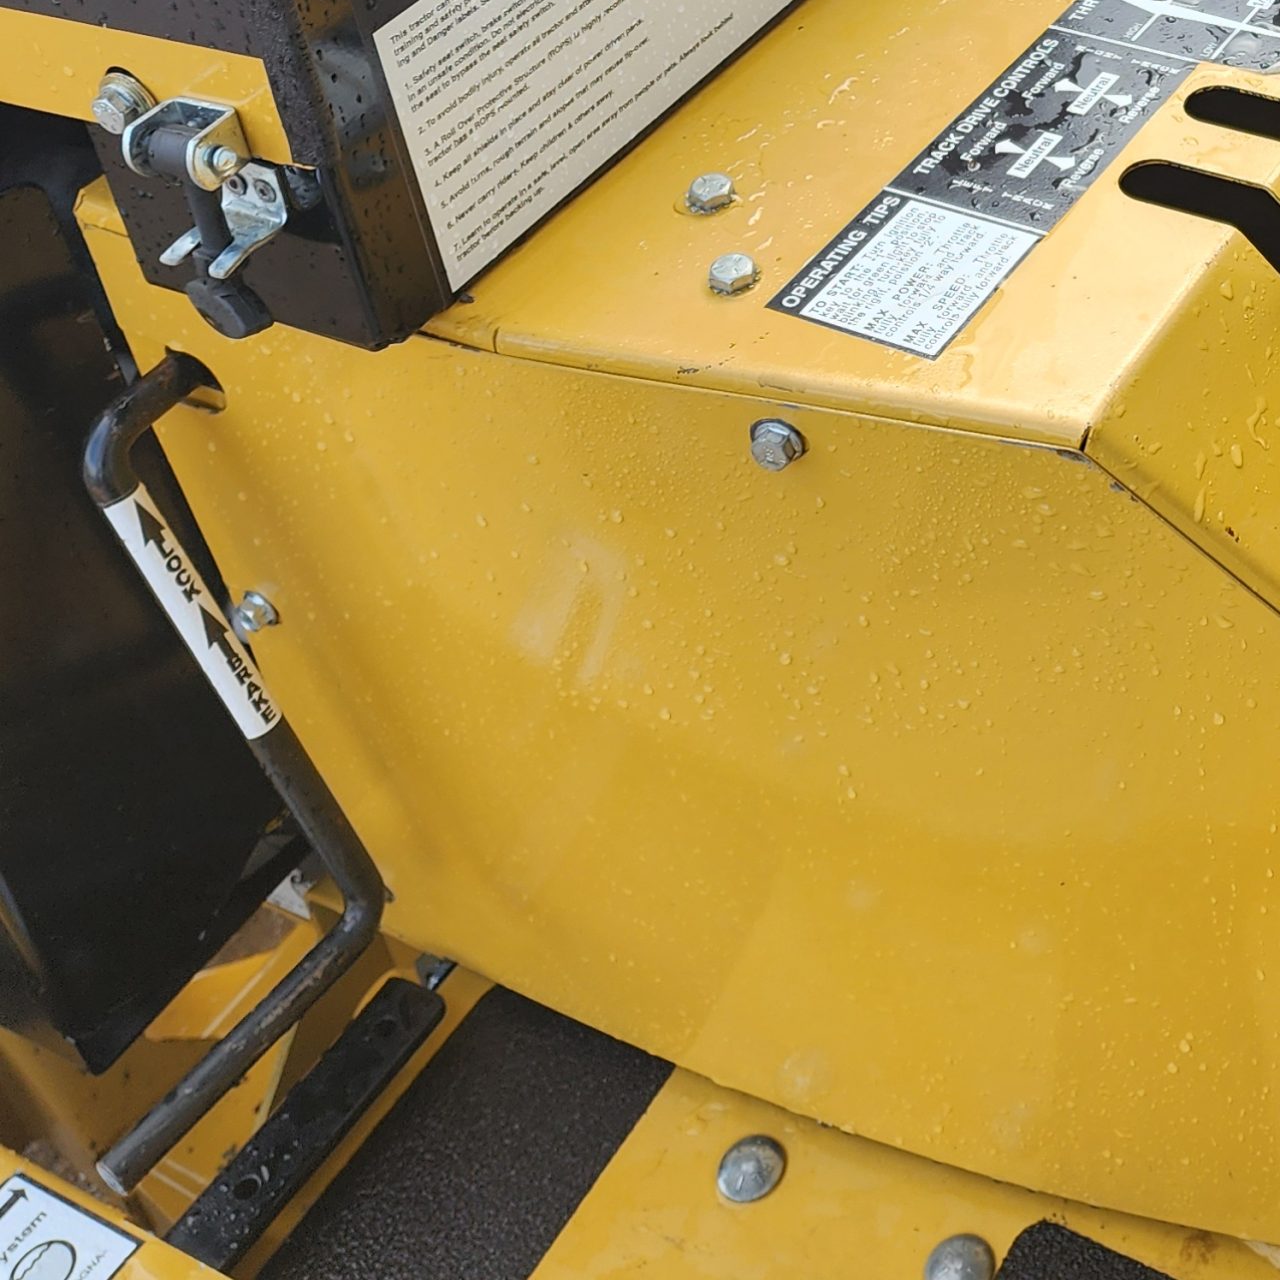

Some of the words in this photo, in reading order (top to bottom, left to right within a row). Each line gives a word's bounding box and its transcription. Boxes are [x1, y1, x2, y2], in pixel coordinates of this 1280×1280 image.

[389, 26, 408, 47] This
[408, 6, 435, 33] tractor
[1198, 42, 1220, 57] LOW
[910, 132, 965, 176] TRACK
[954, 96, 1001, 133] DRIVE
[990, 37, 1061, 98] CONTROLS
[1020, 61, 1066, 99] Forward
[1073, 76, 1111, 109] Neutral
[1118, 84, 1161, 124] Reverse
[959, 120, 1008, 162] Forward
[1013, 136, 1055, 172] Neutral
[1061, 146, 1106, 188] Reverse
[777, 228, 869, 309] OPERATING
[861, 194, 903, 226] TIPS
[808, 300, 828, 314] TO
[825, 263, 864, 296] START:
[862, 239, 887, 259] Turn
[818, 300, 842, 318] key
[839, 286, 854, 296] to
[853, 267, 872, 282] the
[888, 208, 931, 245] position,
[828, 301, 852, 320] wait
[847, 287, 865, 300] for
[861, 261, 892, 287] green
[905, 230, 919, 240] to
[915, 211, 938, 230] stop
[837, 285, 881, 324] blinking,
[913, 225, 937, 244] fully
[933, 214, 947, 223] to
[863, 308, 890, 331] MAX
[891, 261, 933, 300] POWER:
[934, 221, 972, 255] Throttle
[872, 313, 899, 334] fully
[897, 273, 934, 307] forward
[933, 254, 951, 268] and
[954, 223, 980, 245] track
[902, 320, 929, 343] MAX
[931, 273, 971, 311] SPEED:
[973, 231, 1008, 264] Throttle
[847, 311, 867, 326] the
[883, 301, 922, 337] controls
[918, 283, 938, 299] 1/4
[934, 262, 958, 282] way
[911, 325, 937, 347] fully
[936, 284, 973, 319] forward
[972, 264, 991, 278] and
[993, 234, 1018, 256] track
[922, 312, 961, 350] controls
[956, 291, 981, 312] fully
[975, 254, 1012, 290] forward.
[157, 540, 201, 603] LOCK
[227, 652, 276, 725] BRAKE
[0, 1210, 48, 1263] ystem
